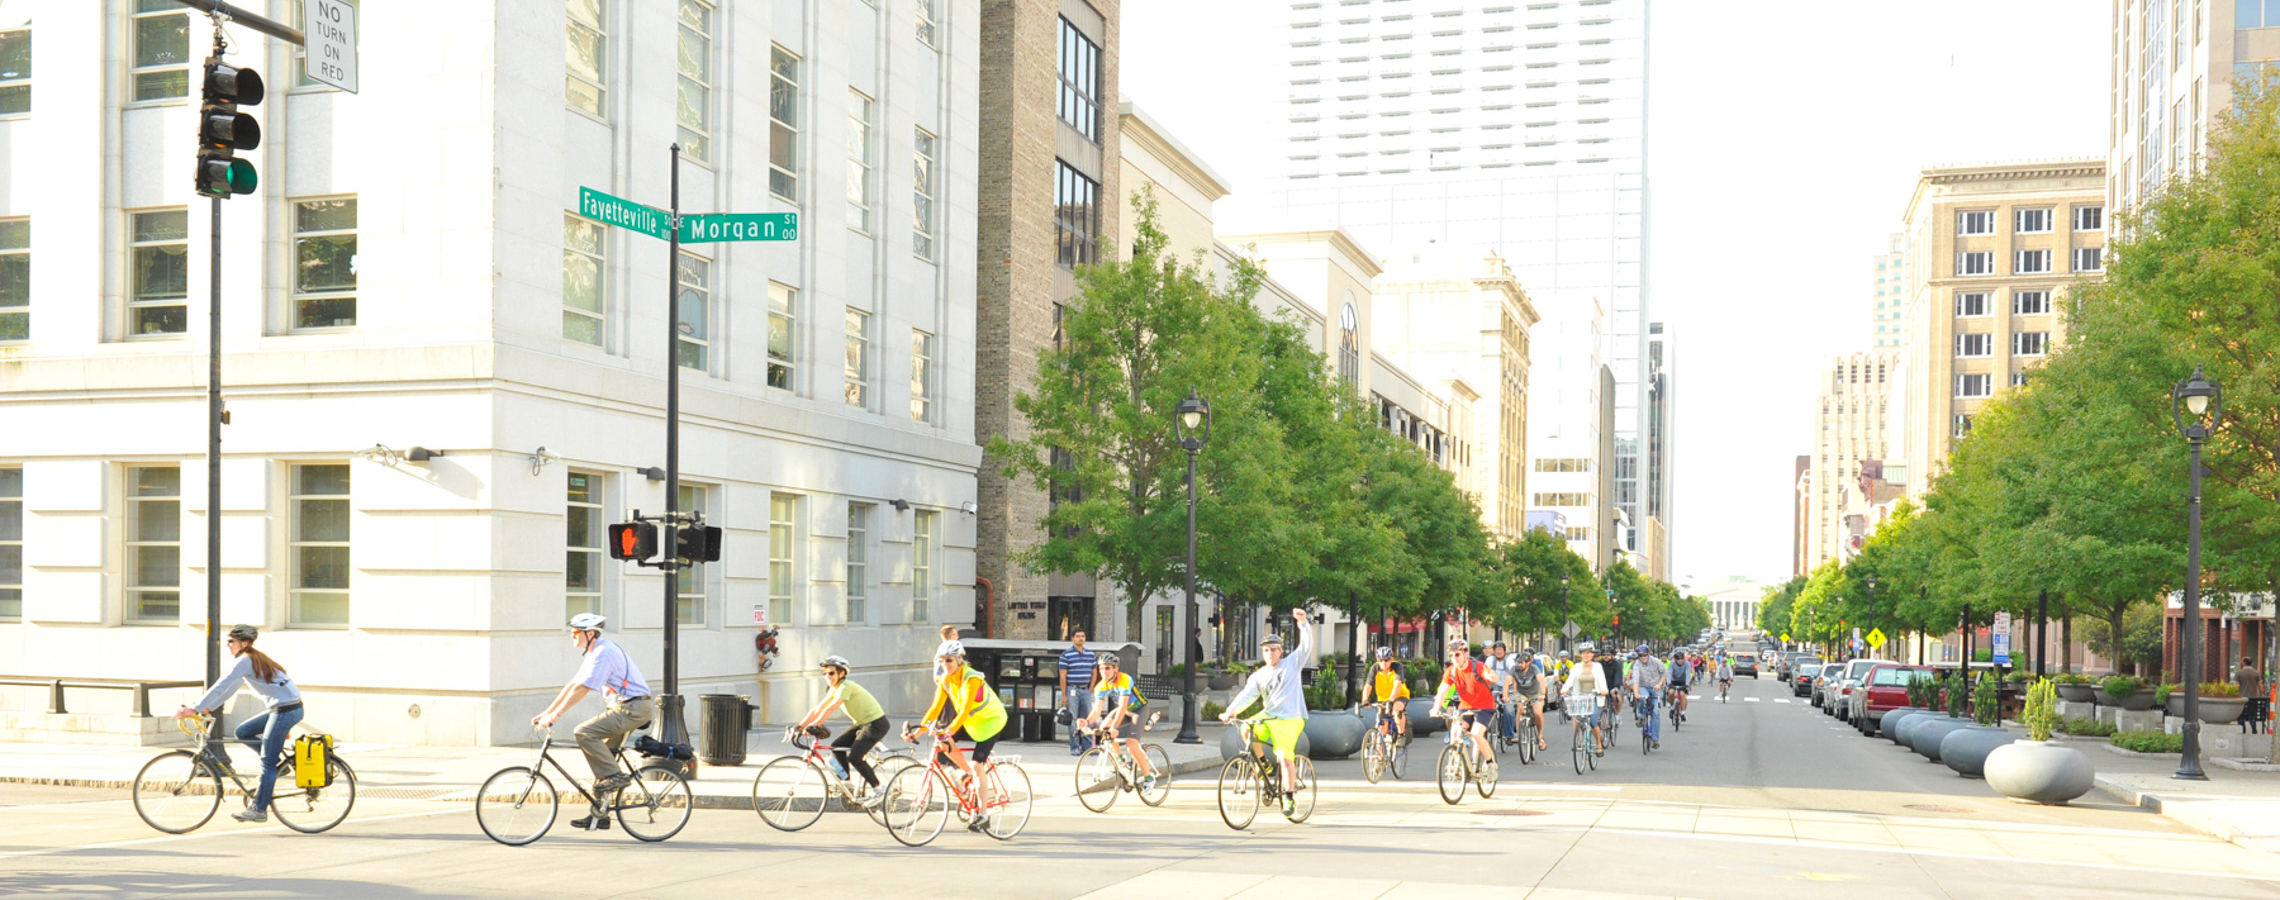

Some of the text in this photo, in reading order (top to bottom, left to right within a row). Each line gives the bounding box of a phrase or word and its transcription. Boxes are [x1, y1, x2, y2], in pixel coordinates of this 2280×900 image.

[318, 1, 341, 23] NO
[316, 21, 346, 45] TURN
[324, 43, 340, 61] ON
[321, 61, 344, 81] RED
[584, 191, 657, 234] Fayetteville
[691, 218, 775, 240] Morgan
[784, 213, 796, 225] St
[782, 228, 796, 240] 00
